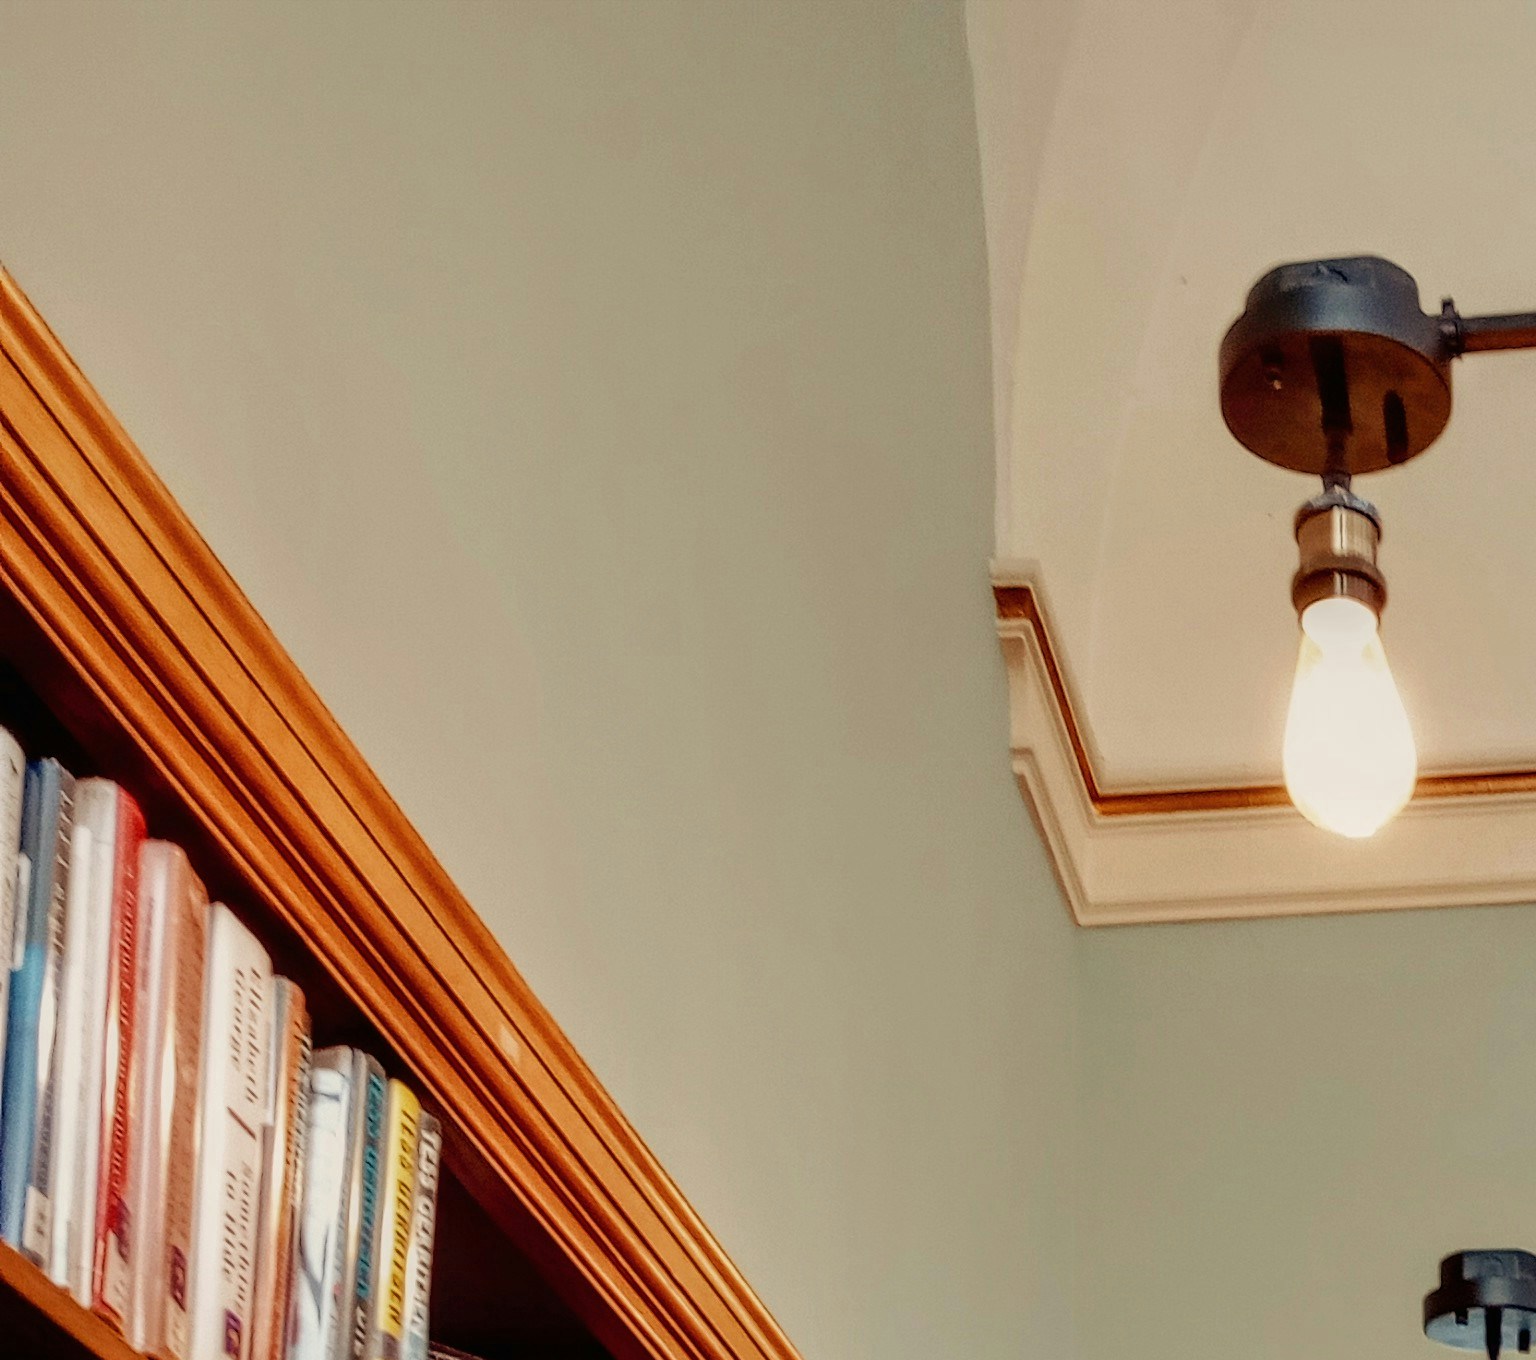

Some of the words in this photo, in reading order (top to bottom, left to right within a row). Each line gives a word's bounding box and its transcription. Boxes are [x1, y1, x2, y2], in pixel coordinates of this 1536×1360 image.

[230, 968, 247, 1064] George
[246, 967, 263, 1104] Elizabeth
[399, 1108, 418, 1172] TESS
[388, 1179, 413, 1328] GERRITSEN
